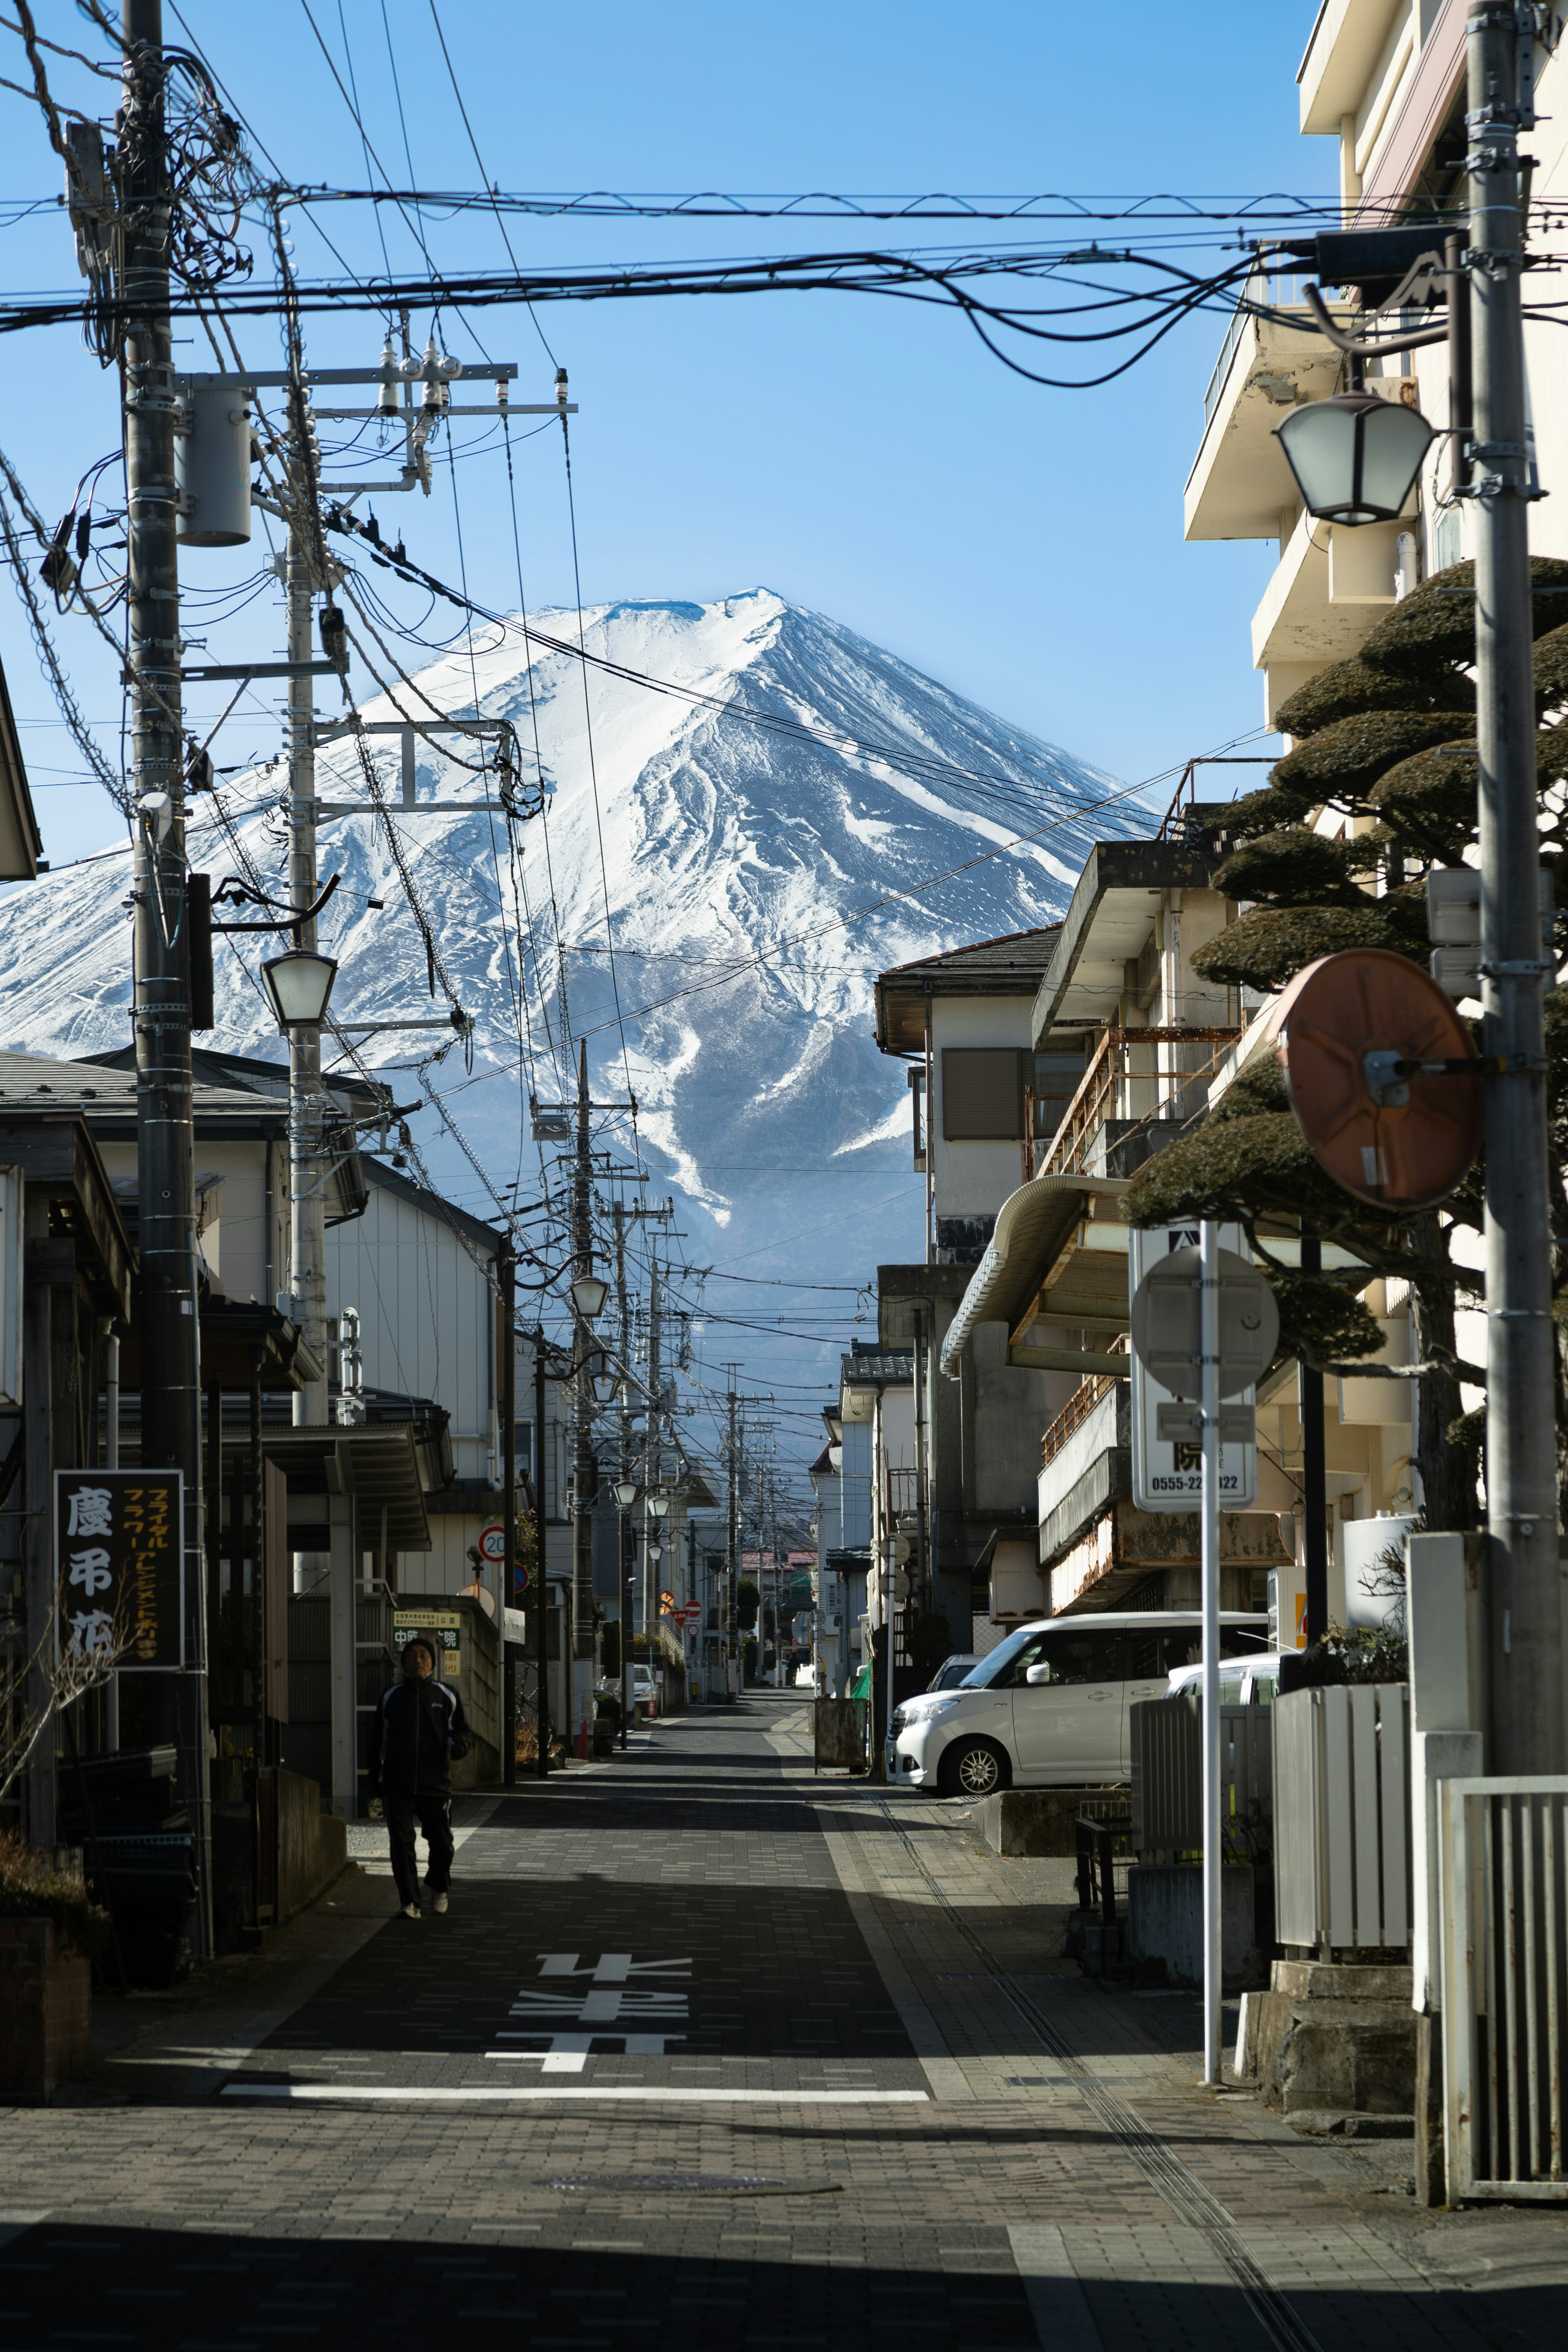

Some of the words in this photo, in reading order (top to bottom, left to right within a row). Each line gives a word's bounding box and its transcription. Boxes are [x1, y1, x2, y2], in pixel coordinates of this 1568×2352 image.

[123, 1489, 144, 1548] フラワー
[148, 1489, 169, 1549] ブライダル
[487, 1537, 505, 1553] 20
